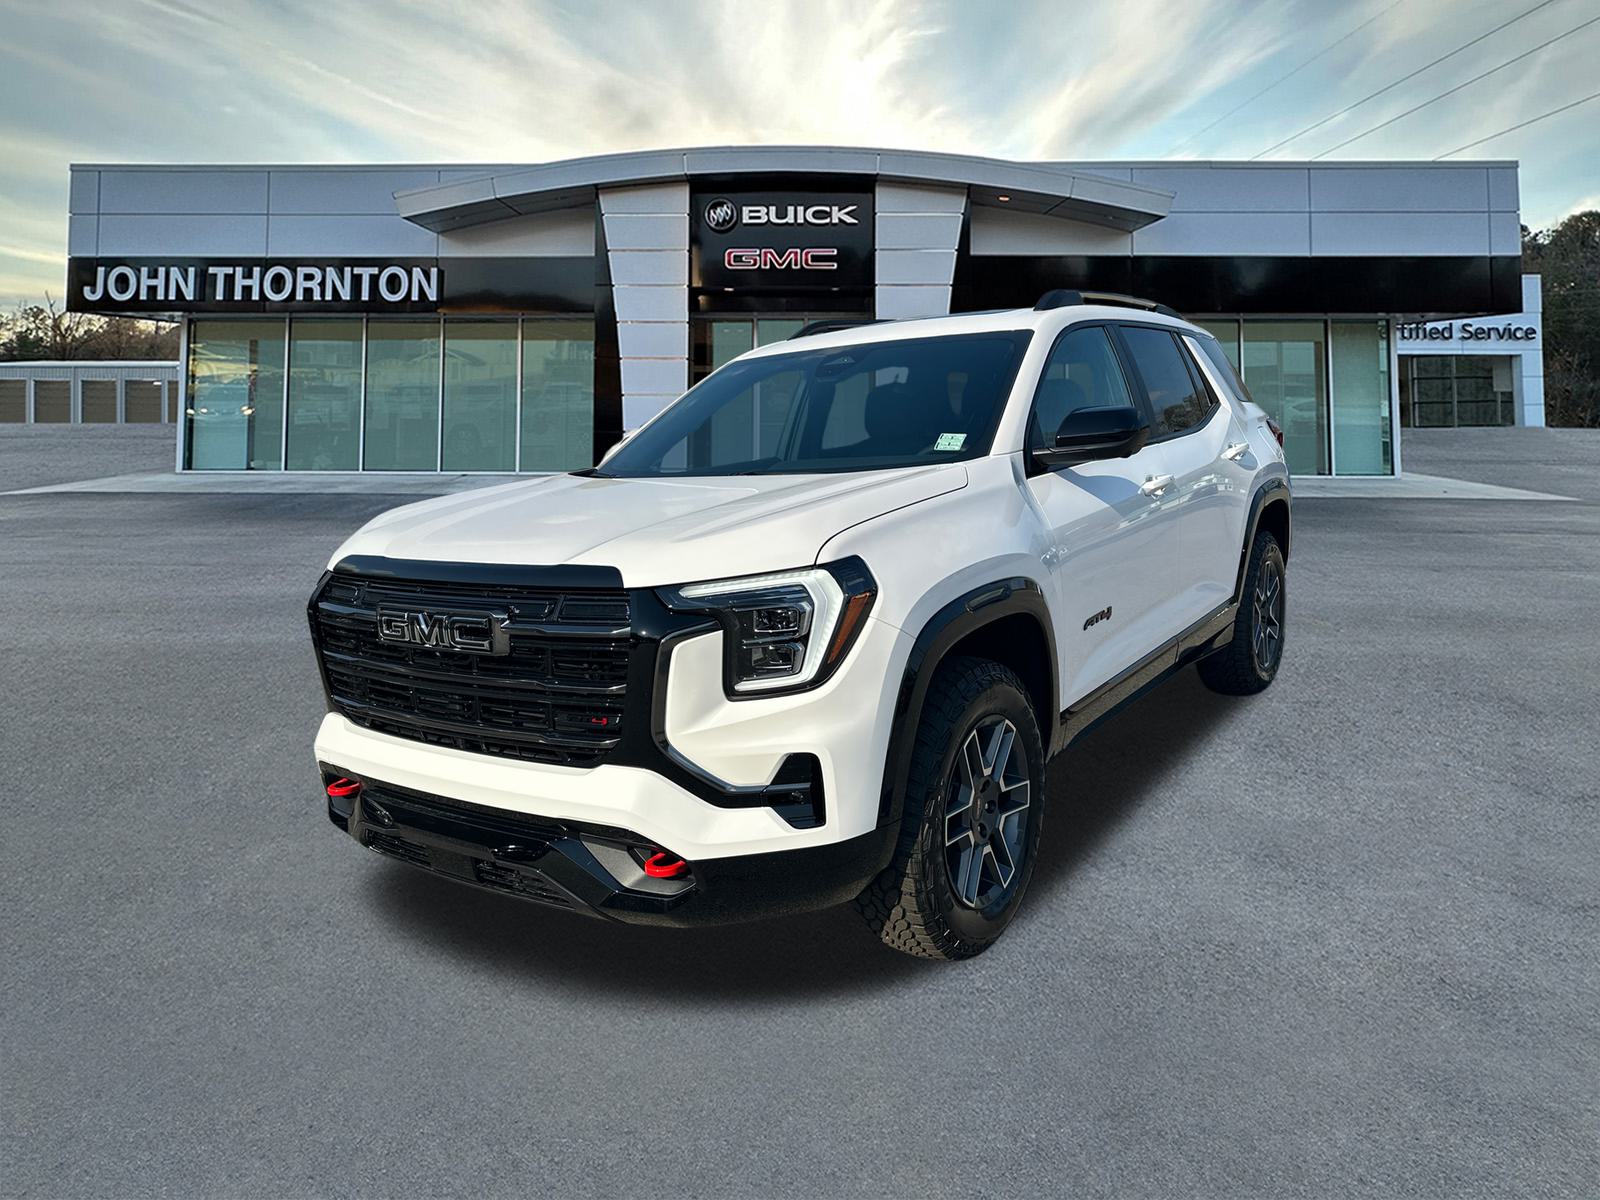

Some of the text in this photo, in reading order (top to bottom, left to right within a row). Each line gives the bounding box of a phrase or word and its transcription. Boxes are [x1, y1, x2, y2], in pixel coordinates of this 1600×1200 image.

[741, 205, 858, 224] BUICK
[724, 248, 838, 270] GMC
[83, 265, 438, 302] JOHN THORNTON
[1460, 323, 1537, 340] Service
[1083, 606, 1112, 631] AT4
[377, 611, 492, 651] GMC
